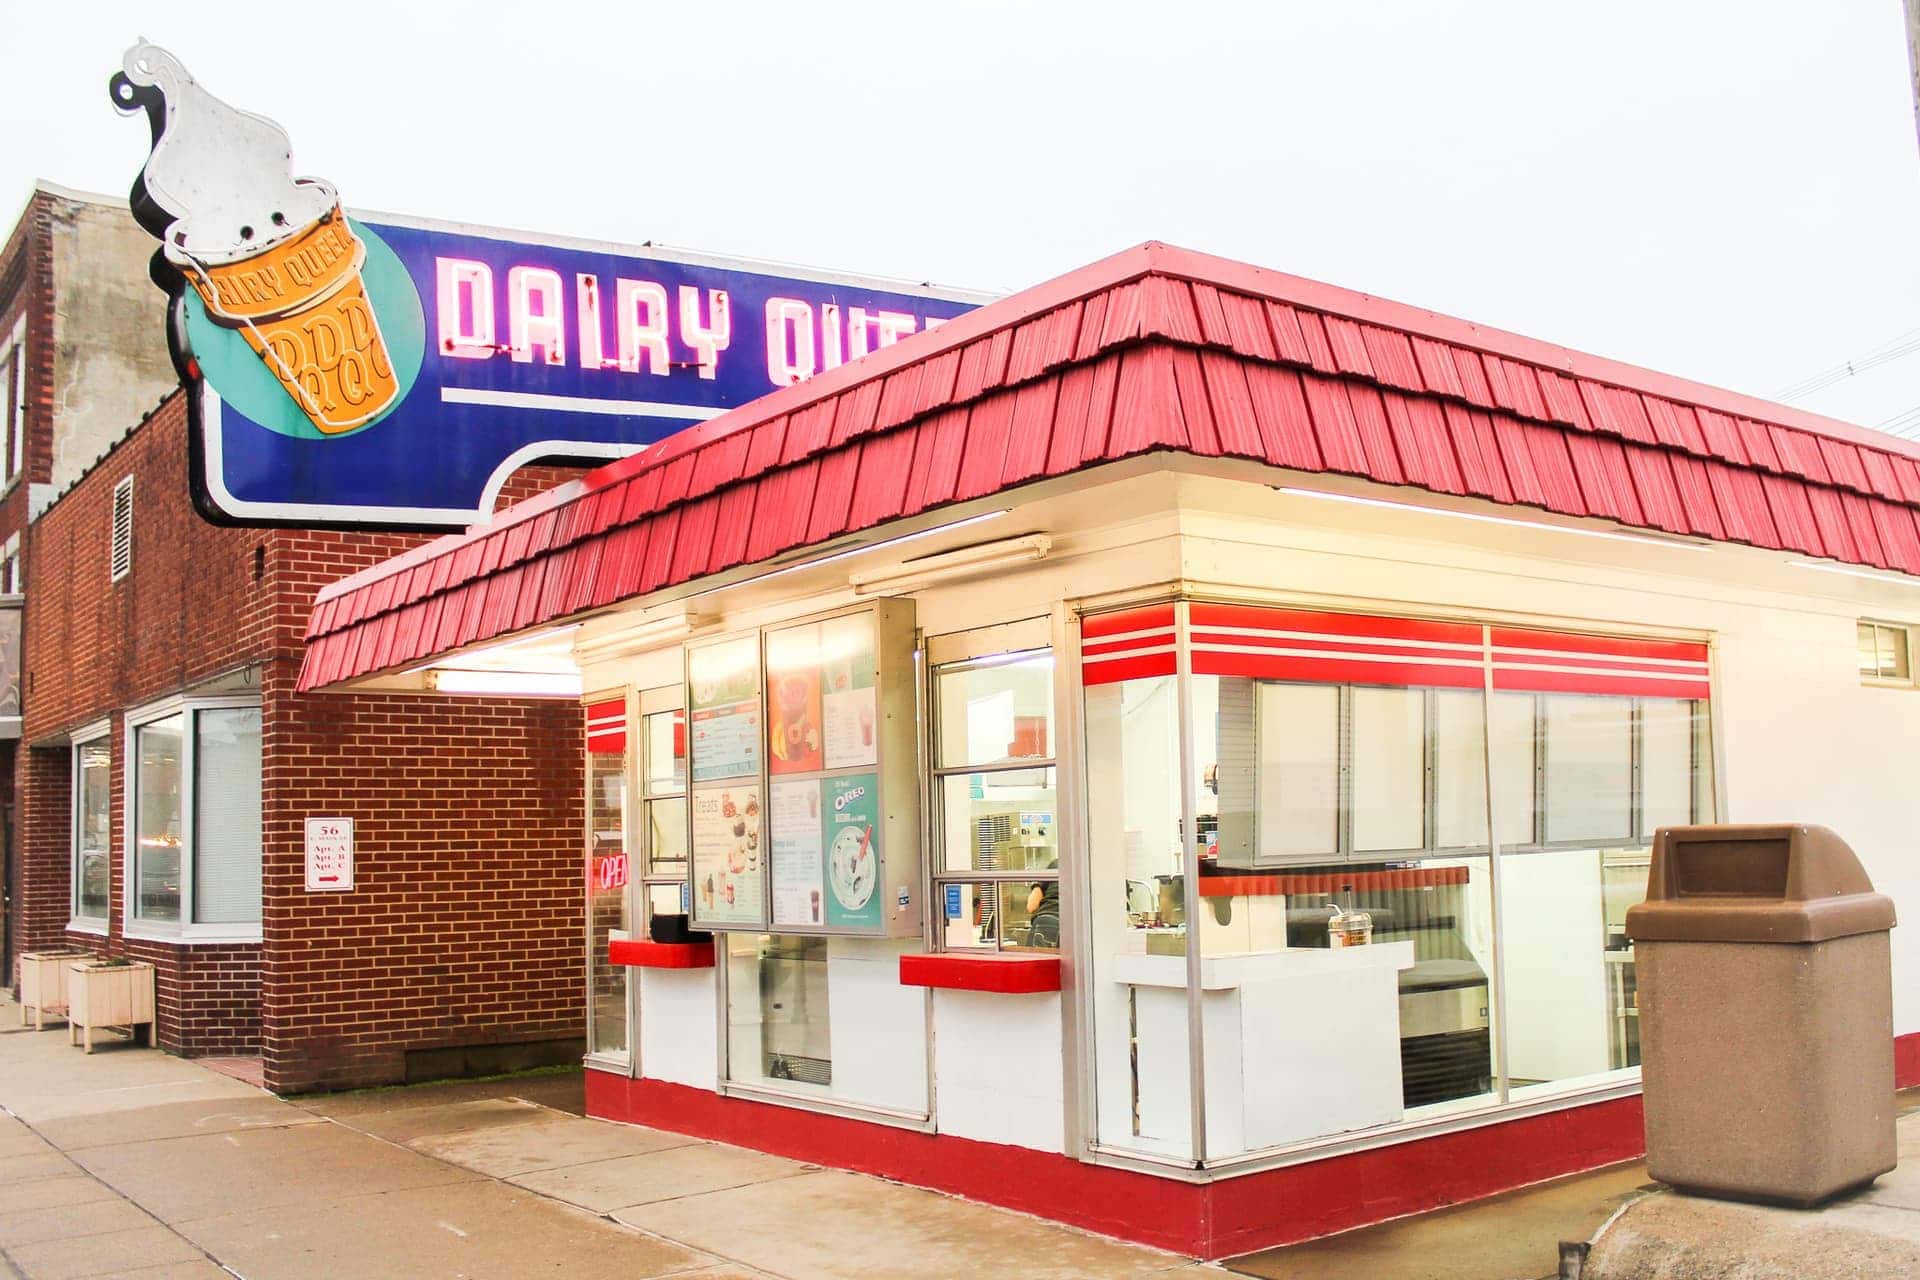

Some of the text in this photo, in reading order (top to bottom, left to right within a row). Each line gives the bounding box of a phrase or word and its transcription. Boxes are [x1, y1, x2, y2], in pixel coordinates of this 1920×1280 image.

[193, 222, 354, 305] DAIRY QUEEN
[436, 256, 951, 388] DAIRY QU
[835, 786, 865, 811] OREO
[321, 826, 338, 836] 56
